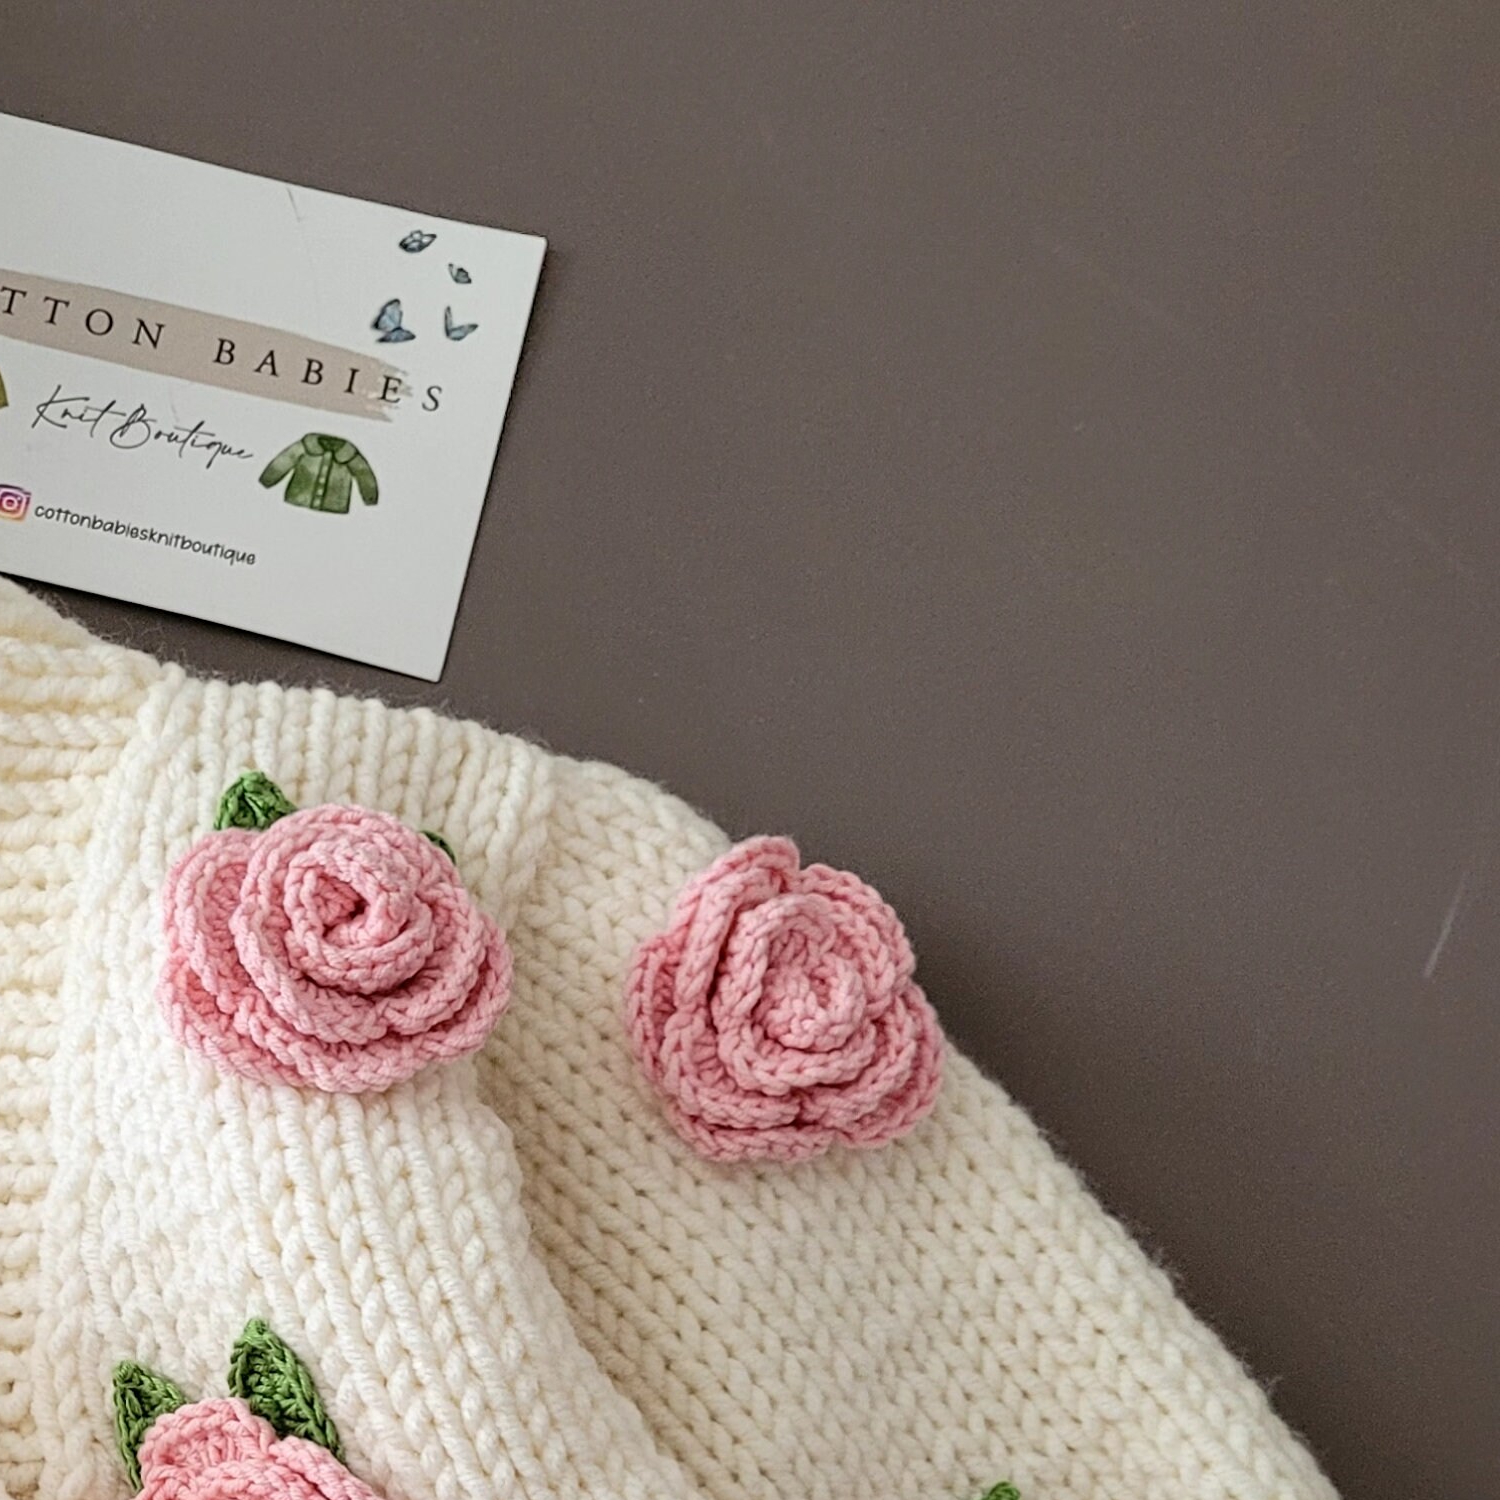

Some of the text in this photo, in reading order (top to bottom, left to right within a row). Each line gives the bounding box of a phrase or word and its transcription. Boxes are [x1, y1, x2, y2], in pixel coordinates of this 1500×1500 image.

[213, 337, 443, 413] BABIES
[31, 385, 254, 469] Knit Boutique
[34, 503, 257, 567] cottonbabiesknitboutique
